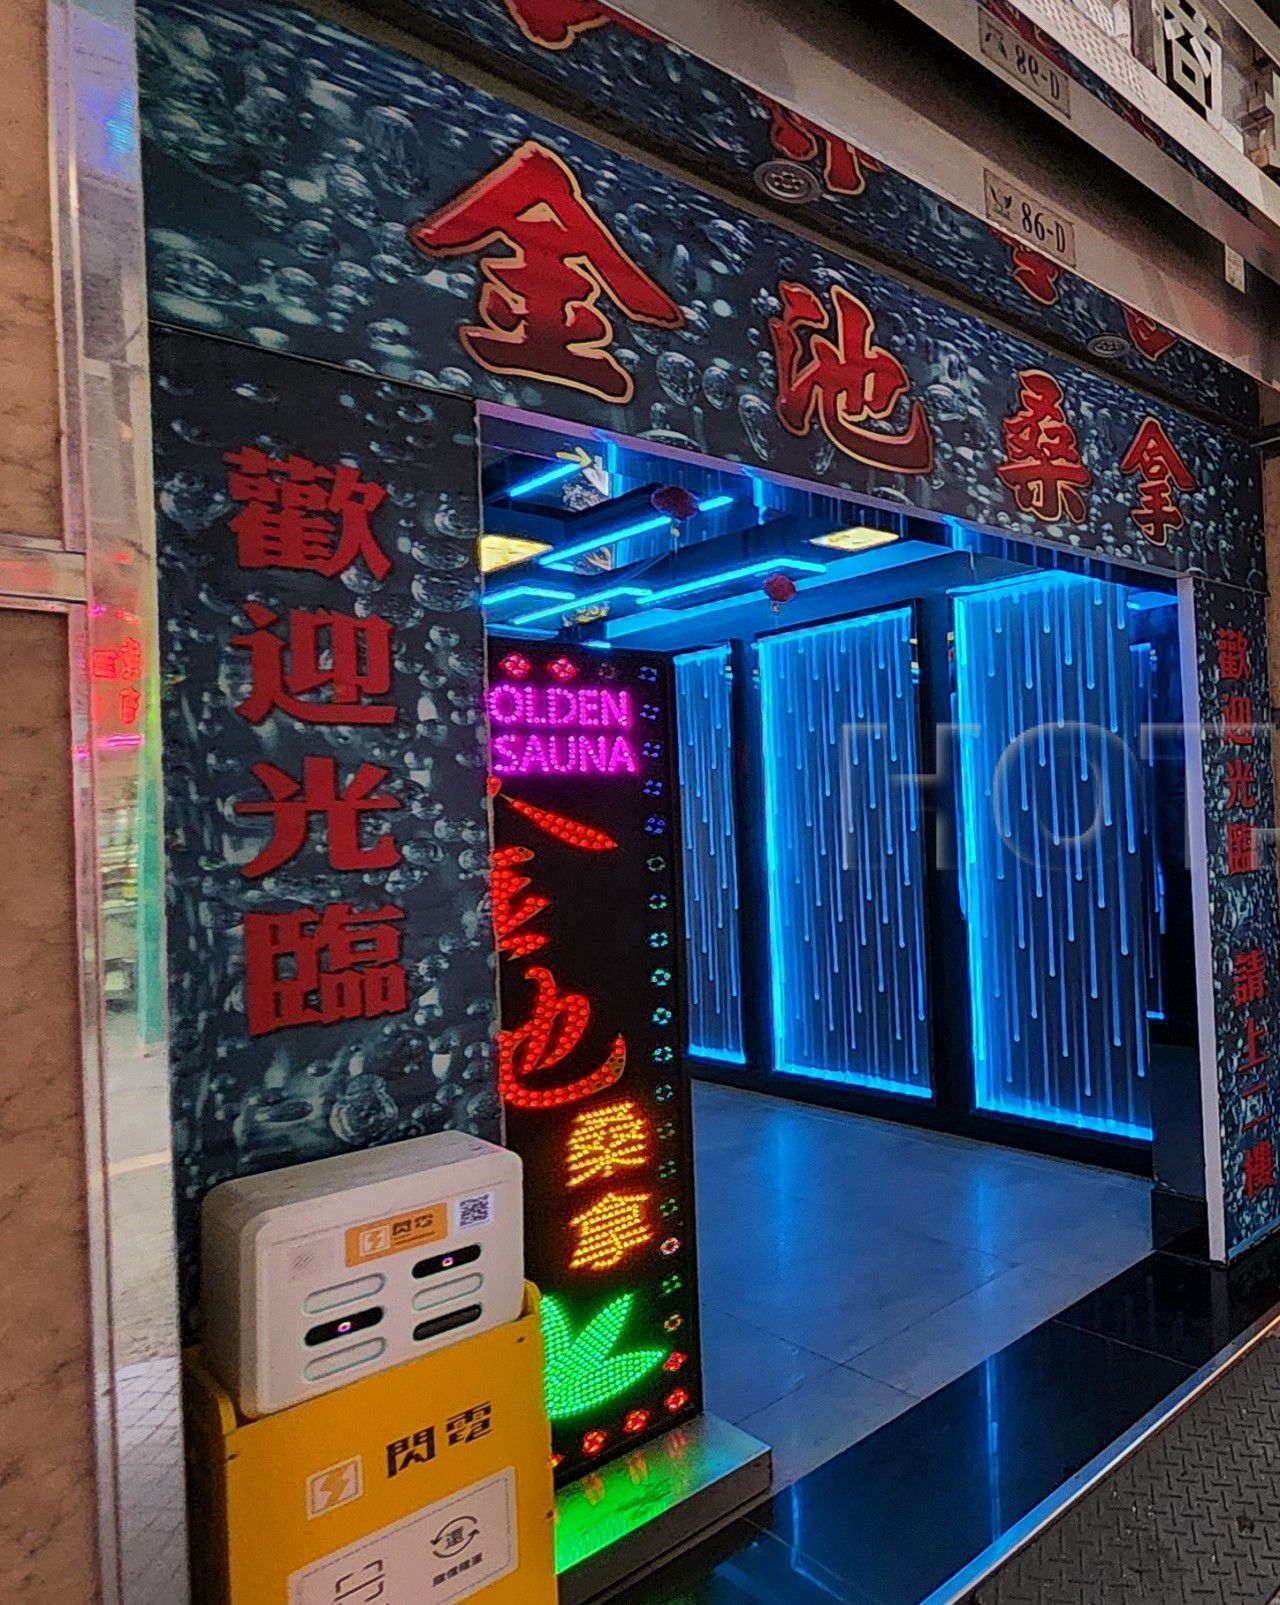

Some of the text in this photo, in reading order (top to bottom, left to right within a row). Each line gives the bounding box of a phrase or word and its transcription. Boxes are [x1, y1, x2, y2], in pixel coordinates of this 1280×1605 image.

[410, 139, 1198, 547] 金池桑拿
[1021, 202, 1066, 254] 86-D
[223, 445, 408, 1036] 歡迎光臨
[493, 733, 636, 773] SAUNA
[1215, 626, 1277, 1201] 歡迎光臨 請上二樓
